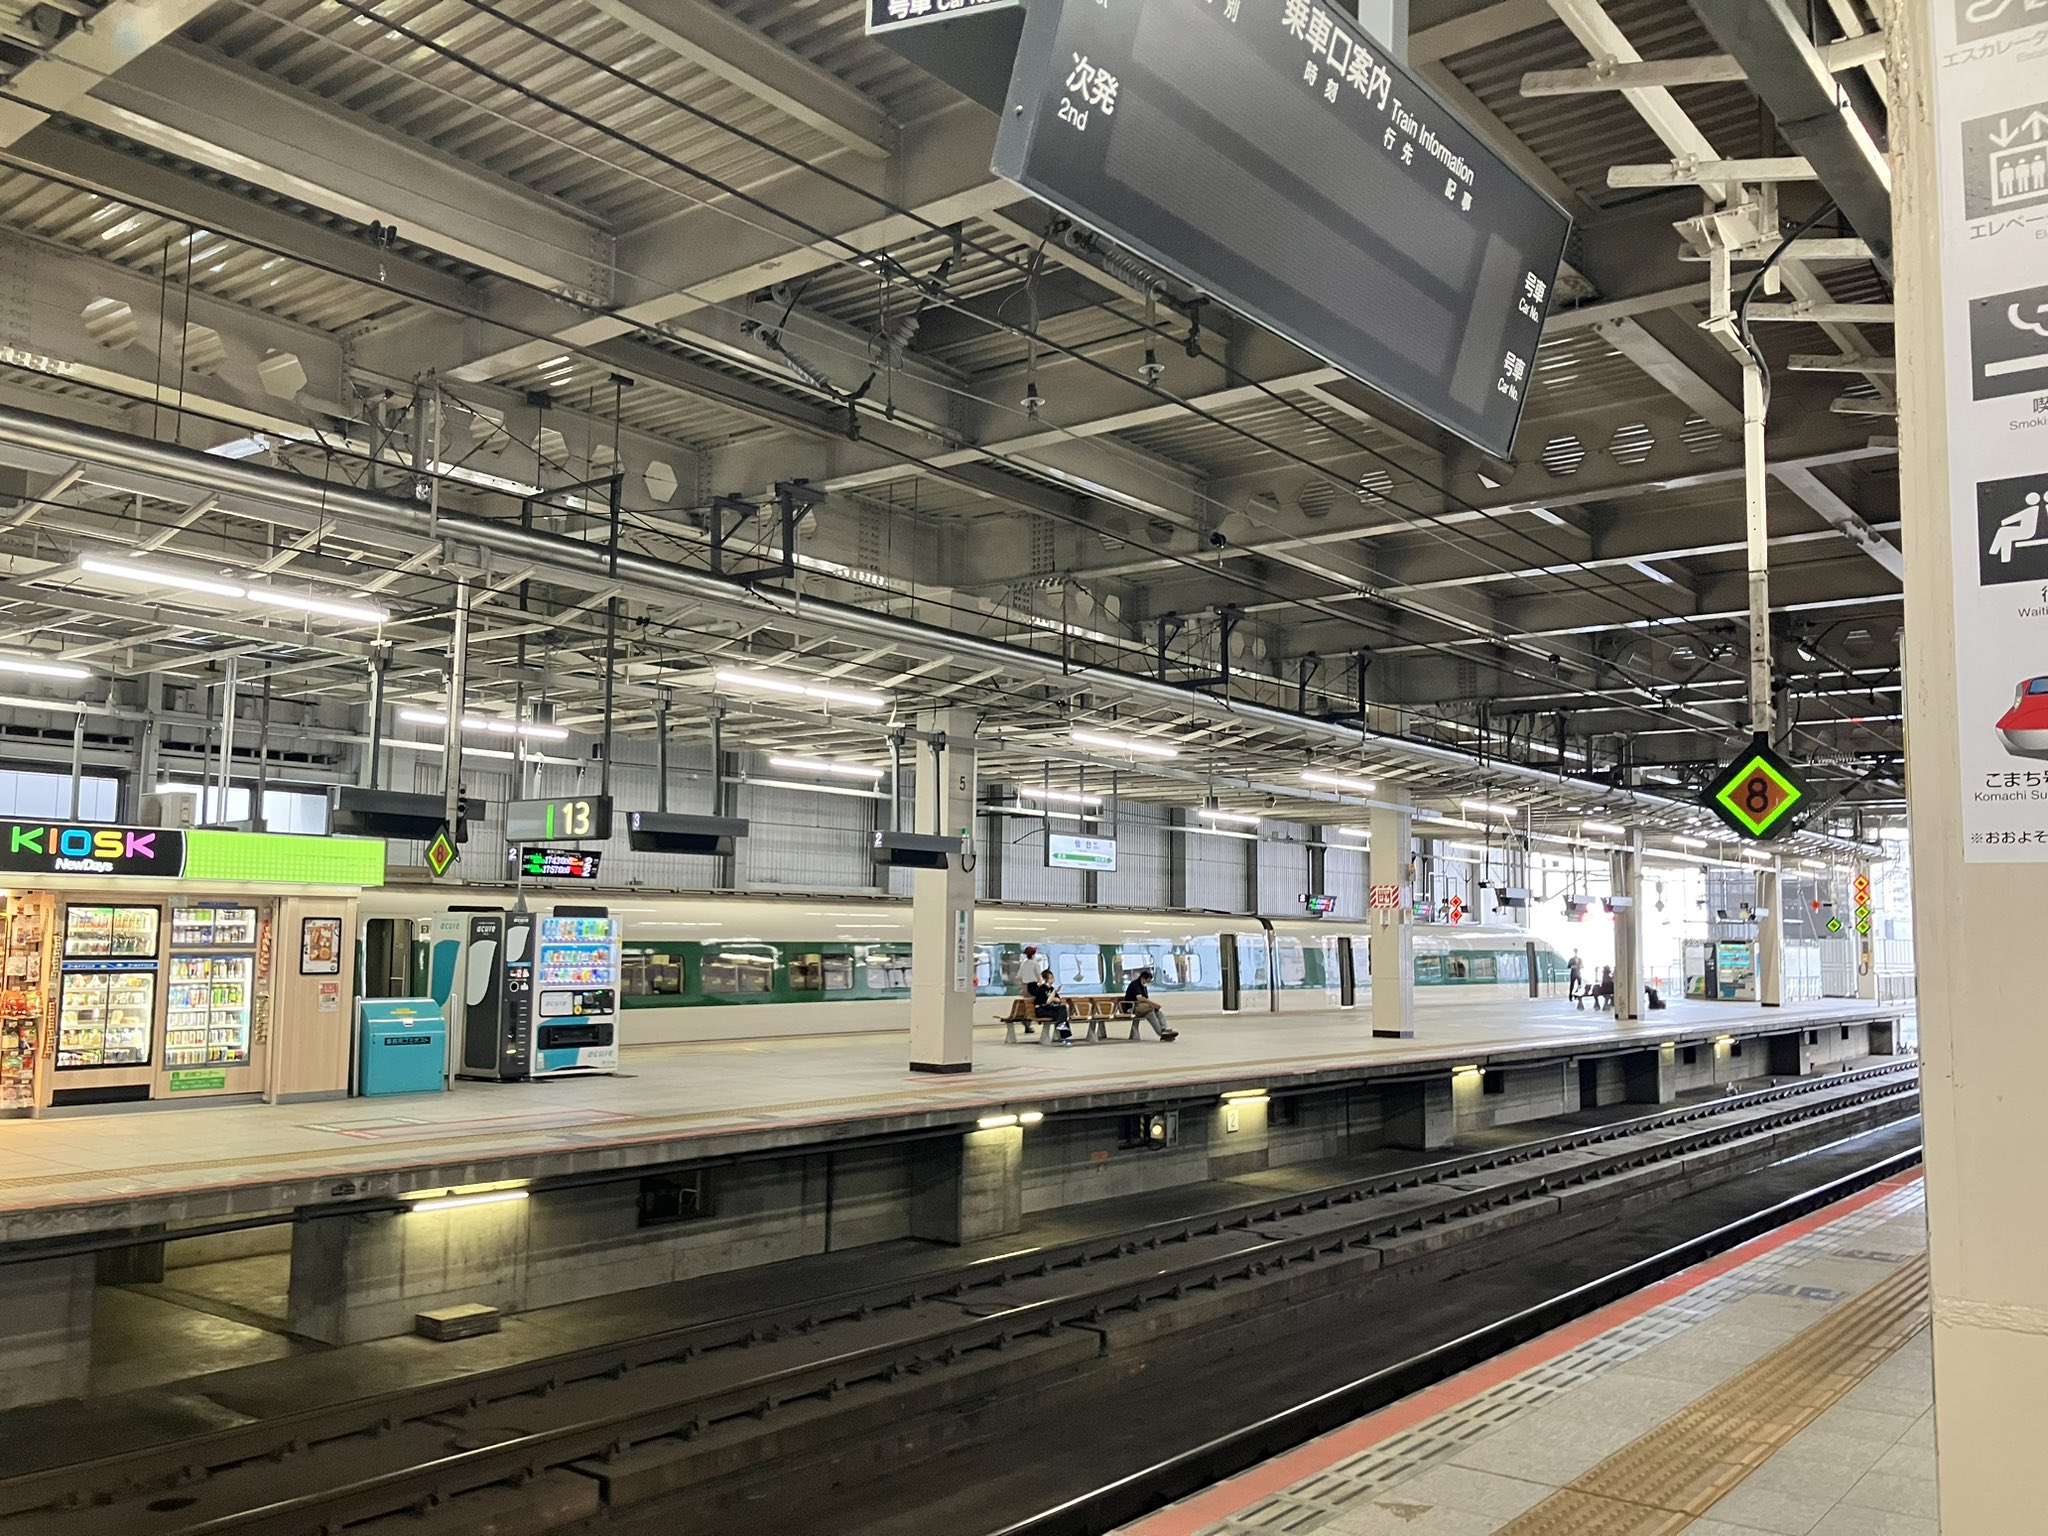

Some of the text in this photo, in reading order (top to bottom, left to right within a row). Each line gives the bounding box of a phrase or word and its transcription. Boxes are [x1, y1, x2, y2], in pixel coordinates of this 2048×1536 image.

[1066, 51, 1119, 116] 次発
[1282, 0, 1475, 187] 乗車口案内 Train Information
[1057, 97, 1089, 132] 2nd
[1970, 214, 2048, 240] エレベー
[1524, 271, 1547, 303] 号車
[1518, 297, 1539, 323] Car No.
[1503, 350, 1526, 382] 号車
[1497, 377, 1518, 401] Car No.
[959, 775, 966, 791] 5
[1746, 777, 1769, 814] 8
[1974, 791, 2027, 802] Komachi
[562, 801, 590, 835] 13
[11, 826, 156, 859] KIOSK
[875, 832, 882, 844] 2
[55, 857, 114, 873] NewDays
[508, 848, 517, 861] 2
[476, 925, 496, 933] acure
[587, 1050, 613, 1058] acure
